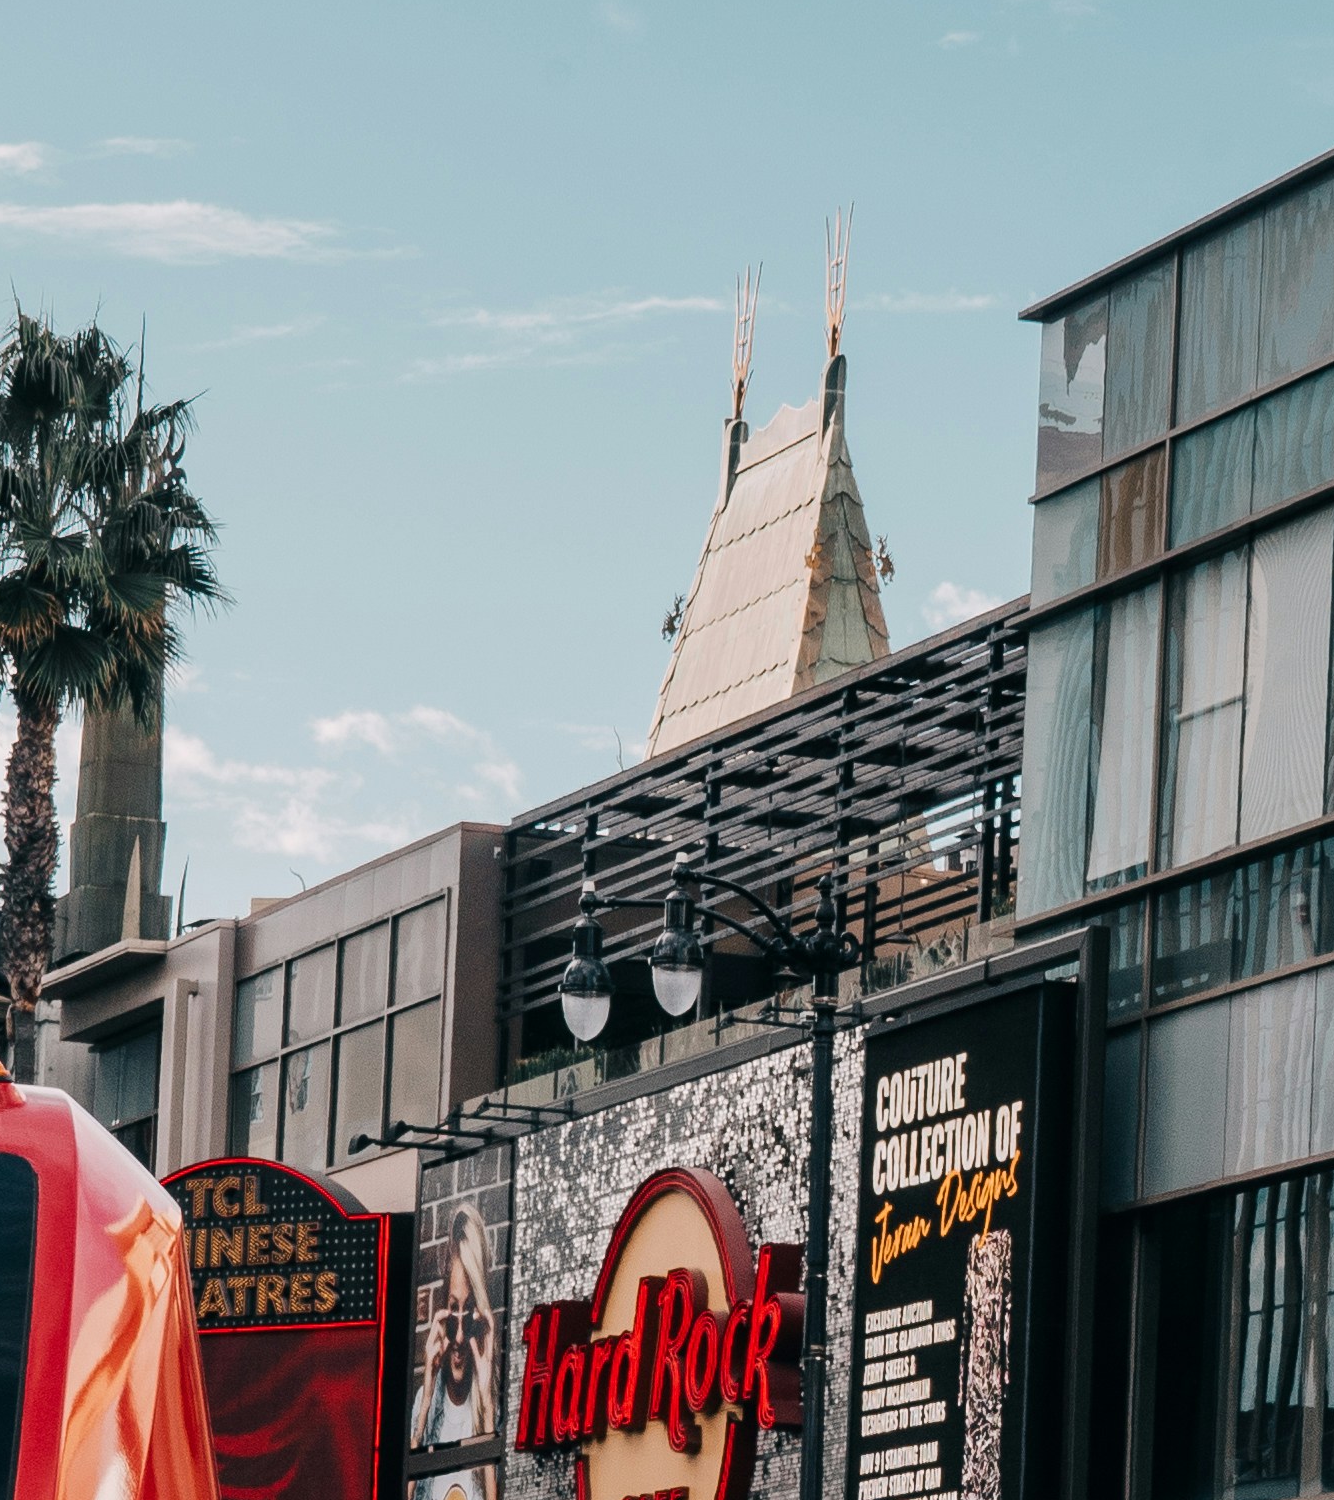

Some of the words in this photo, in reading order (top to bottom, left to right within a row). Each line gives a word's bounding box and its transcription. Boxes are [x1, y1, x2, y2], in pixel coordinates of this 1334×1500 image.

[875, 1051, 968, 1132] COUTURE
[872, 1109, 991, 1195] COLLECTION
[995, 1100, 1023, 1164] OF
[186, 1175, 267, 1219] TCL
[936, 1149, 1021, 1250] Designs
[196, 1270, 340, 1319] ATRES
[515, 1275, 650, 1451] Hard
[648, 1242, 785, 1453] Rock
[885, 1332, 899, 1355] THE
[899, 1408, 909, 1430] TO
[909, 1404, 923, 1427] THE
[923, 1400, 947, 1424] STARS
[859, 1452, 874, 1476] NOV
[884, 1444, 919, 1470] STARTING
[889, 1471, 915, 1497] STARTS
[915, 1469, 924, 1492] AT
